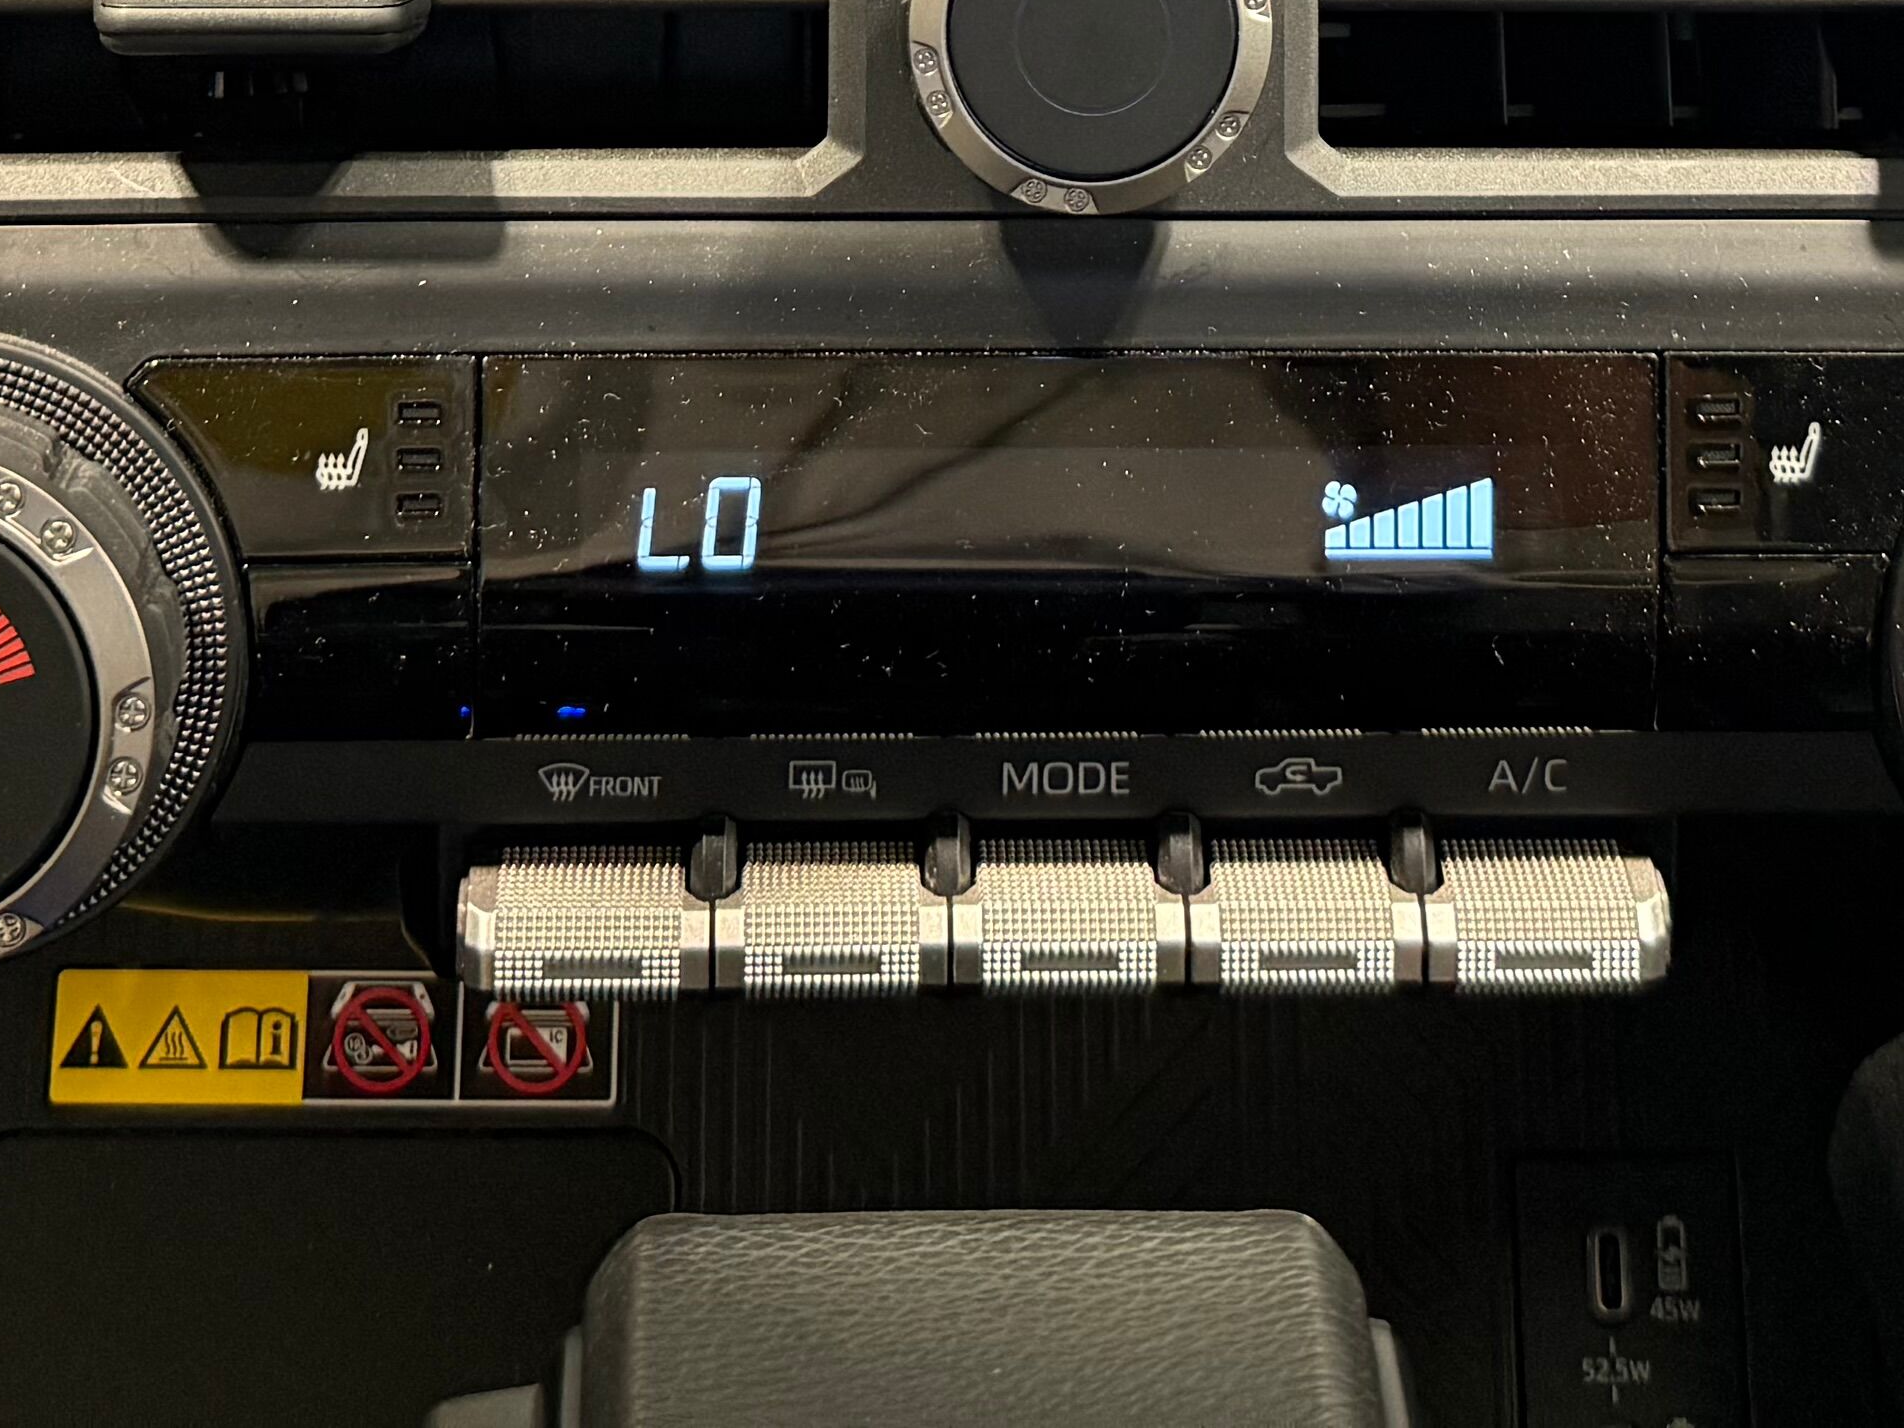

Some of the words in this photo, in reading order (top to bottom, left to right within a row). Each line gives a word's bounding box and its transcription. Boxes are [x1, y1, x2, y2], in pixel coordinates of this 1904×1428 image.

[637, 476, 760, 573] LO
[589, 775, 662, 798] FRONT
[1001, 760, 1130, 796] MODE
[1489, 757, 1570, 795] A/C
[1649, 1296, 1701, 1322] 45W
[1581, 1356, 1651, 1385] 52.5W
